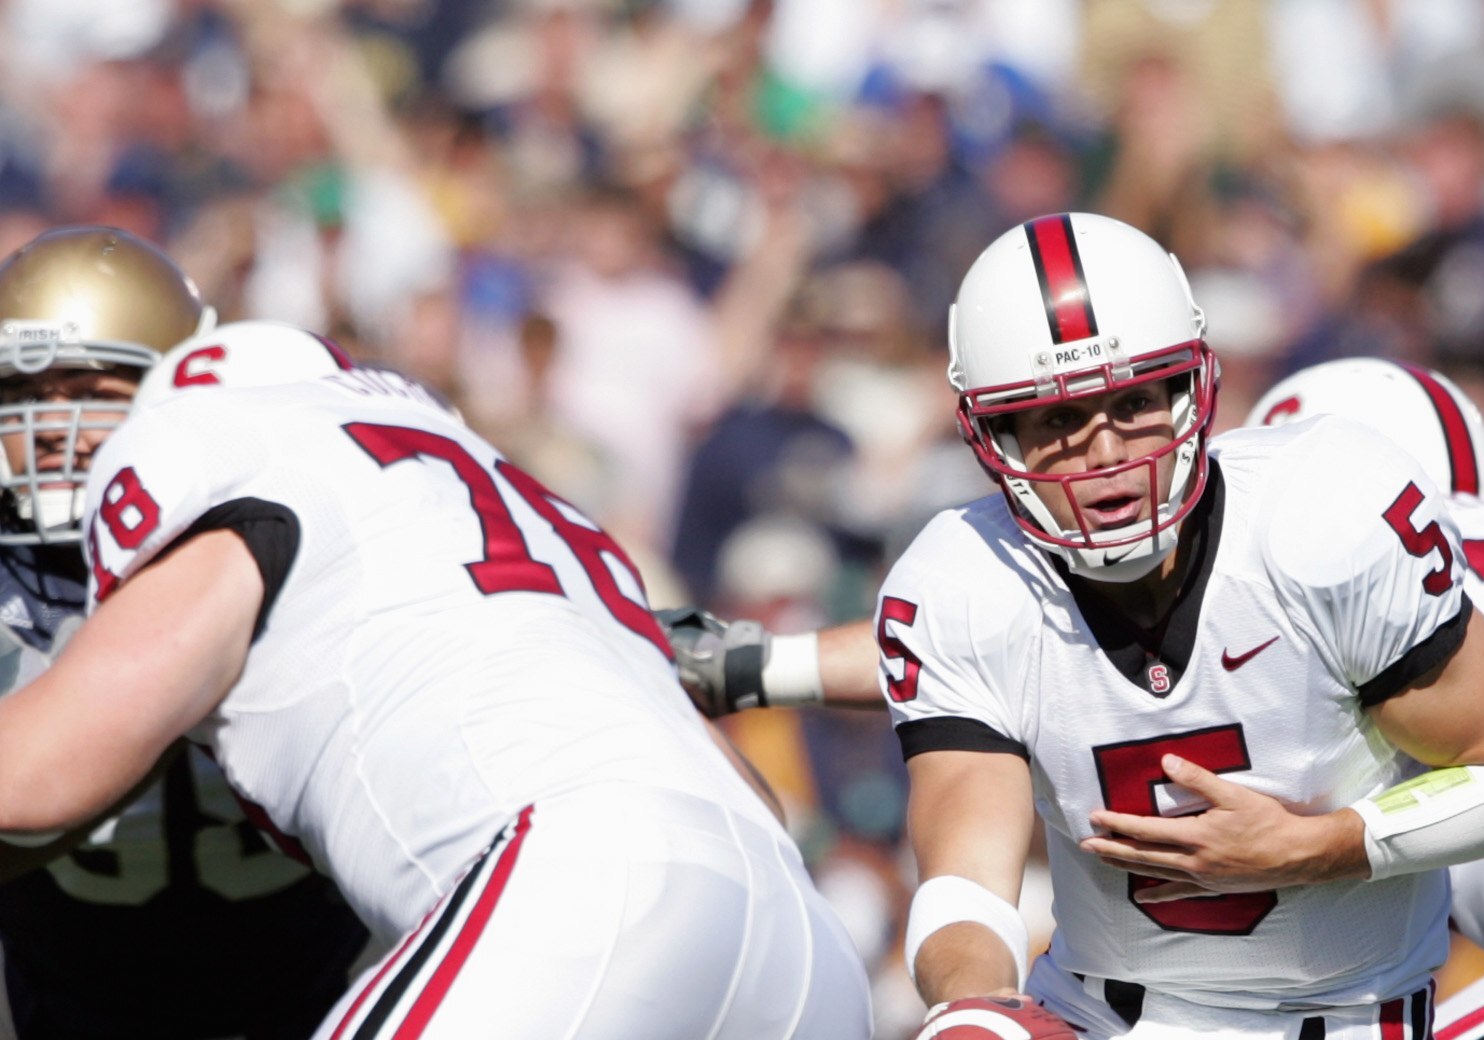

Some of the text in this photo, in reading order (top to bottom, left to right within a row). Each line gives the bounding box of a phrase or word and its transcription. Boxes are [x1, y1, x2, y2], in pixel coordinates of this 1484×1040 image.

[1055, 344, 1101, 365] PAC-10
[1382, 481, 1455, 598] 5
[872, 594, 918, 702] 5
[1149, 664, 1170, 693] S
